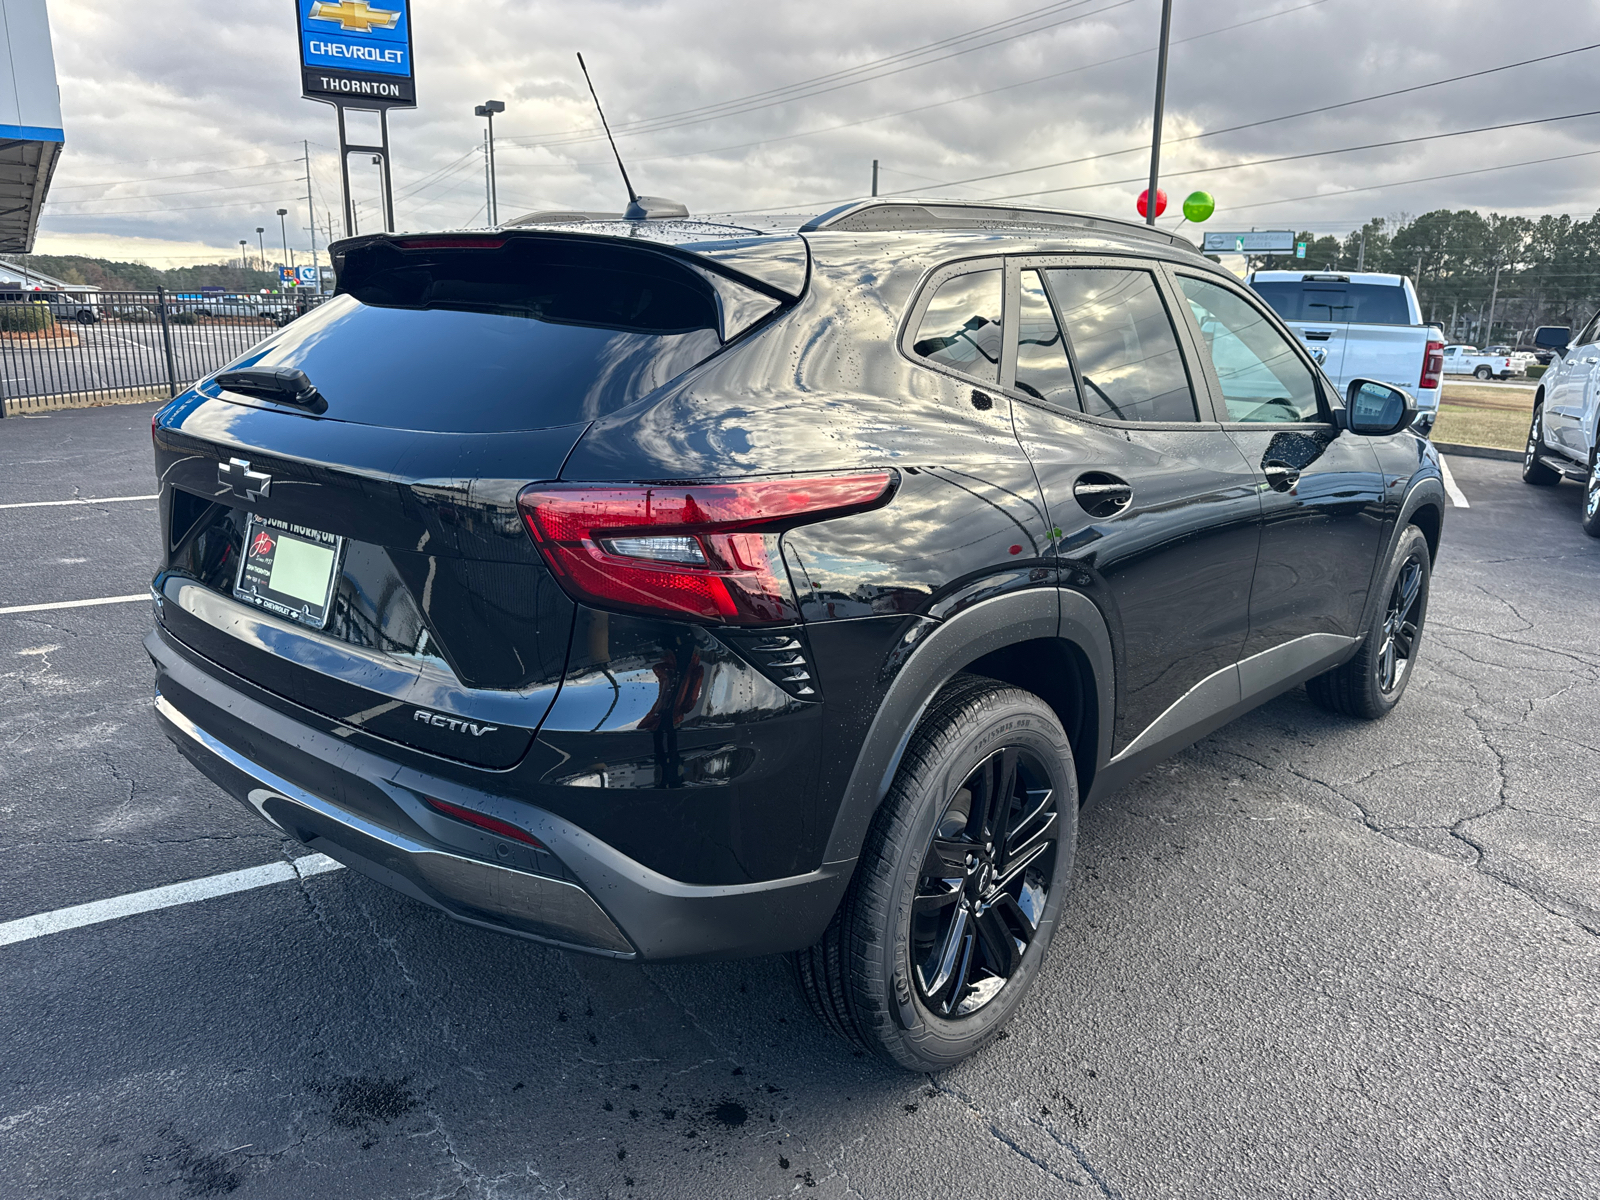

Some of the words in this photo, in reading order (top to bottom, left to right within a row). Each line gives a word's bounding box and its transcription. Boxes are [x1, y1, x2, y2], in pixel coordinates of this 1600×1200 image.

[310, 41, 404, 64] CHEVROLET
[320, 77, 399, 96] THORNTON
[263, 600, 290, 616] CHEVROLET
[413, 710, 498, 737] ACTIV
[894, 849, 922, 1007] GOODYEAR
